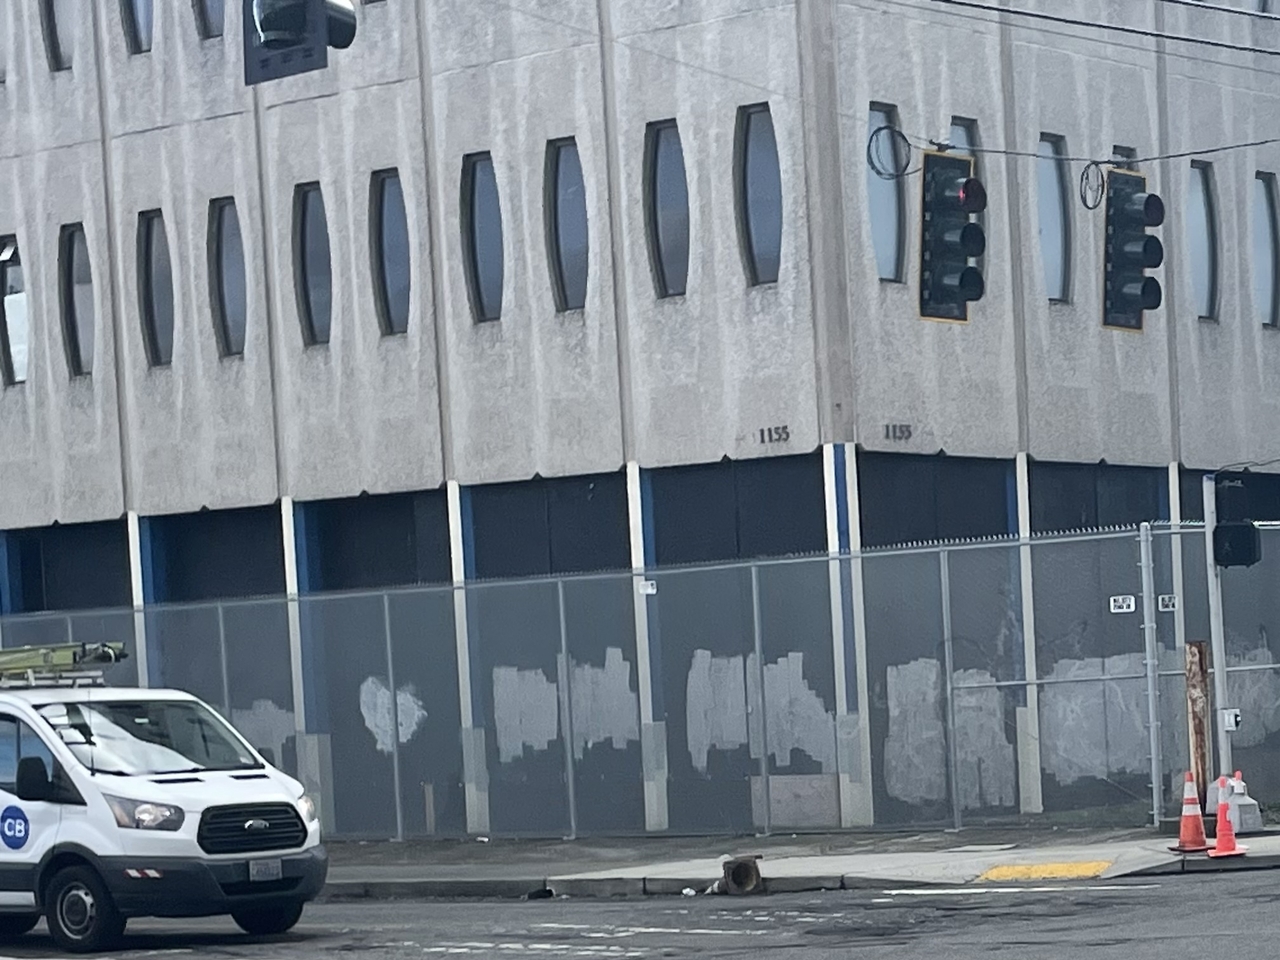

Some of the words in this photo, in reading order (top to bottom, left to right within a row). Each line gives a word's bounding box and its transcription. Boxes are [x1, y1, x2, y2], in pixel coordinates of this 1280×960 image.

[759, 425, 790, 444] 1155
[884, 424, 912, 440] 1155
[4, 818, 25, 837] CB
